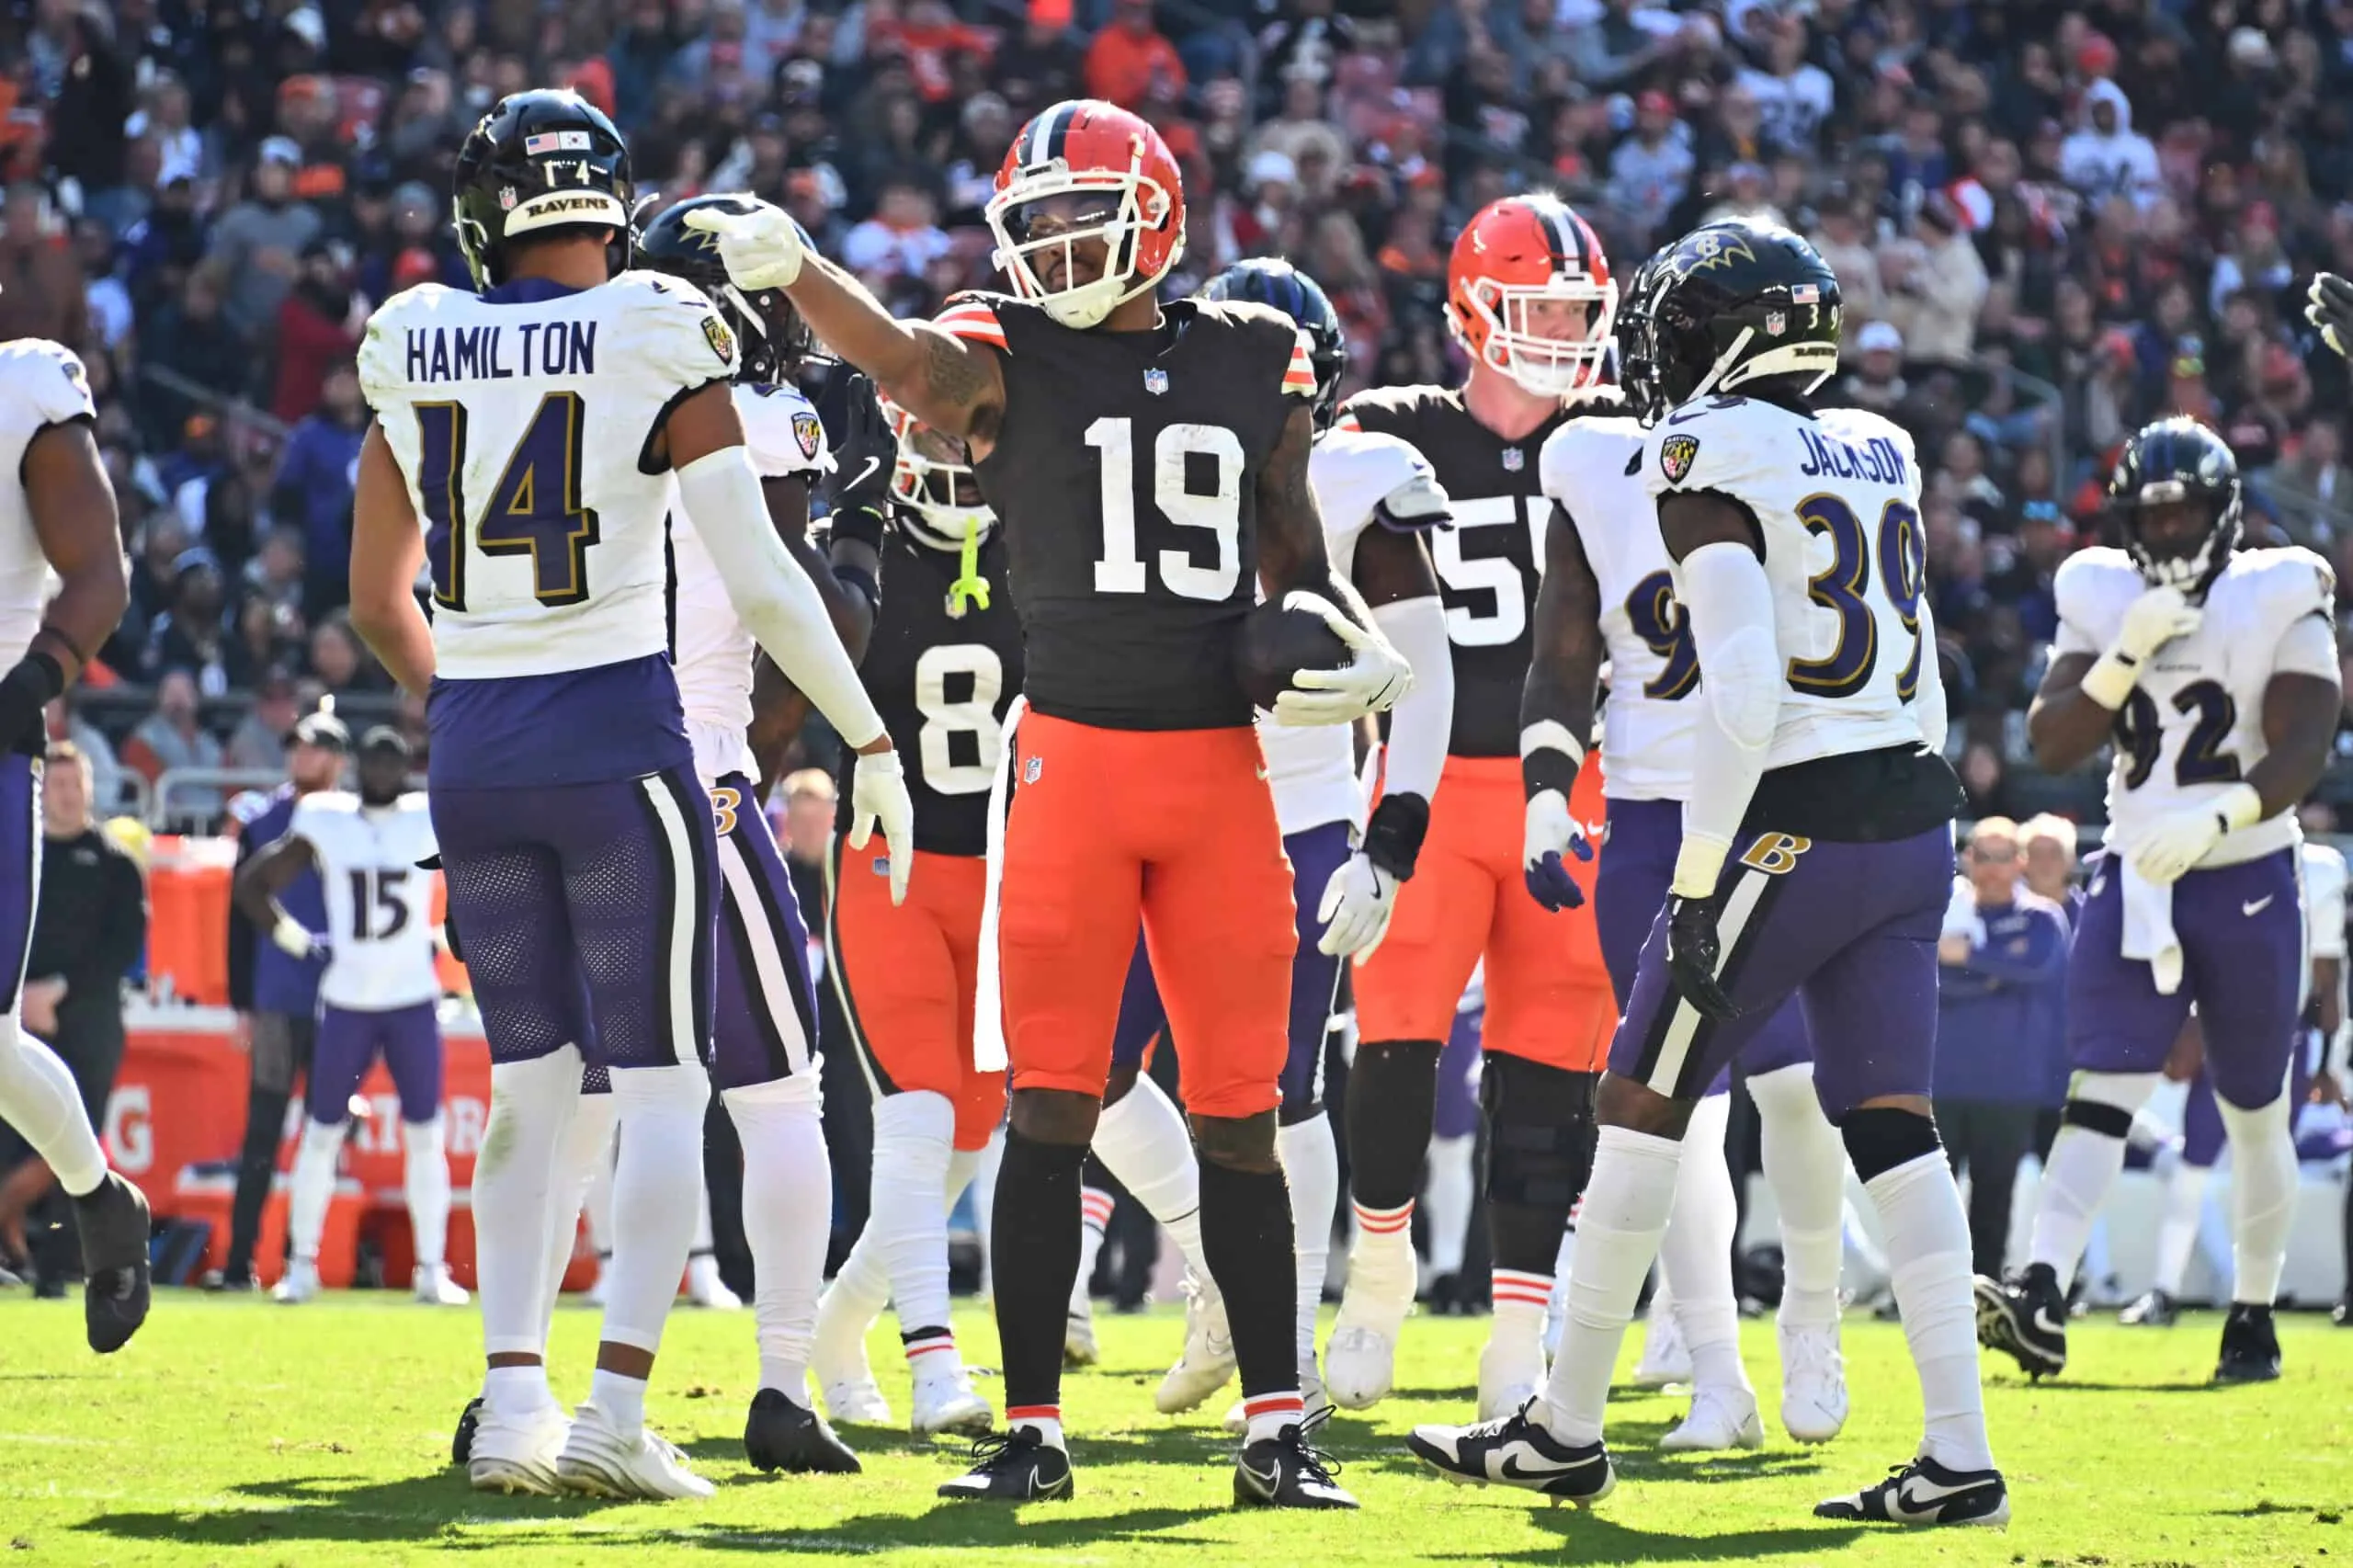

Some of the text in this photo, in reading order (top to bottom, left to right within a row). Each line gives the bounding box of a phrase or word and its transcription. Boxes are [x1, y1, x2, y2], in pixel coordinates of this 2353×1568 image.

[526, 197, 610, 218] RAVENS
[543, 158, 590, 188] 14
[407, 321, 597, 383] HAMILTON
[1797, 426, 1907, 485] JACKSON
[411, 391, 601, 613] 14
[1084, 416, 1245, 601] 19
[1431, 494, 1553, 647] 5
[1786, 491, 1927, 707] 39
[1624, 569, 1702, 700] 9
[915, 643, 1004, 796] 8
[2112, 678, 2243, 793] 92
[709, 787, 742, 838] B
[1739, 831, 1812, 875] B
[347, 869, 410, 941] 15
[106, 1085, 154, 1172] G
